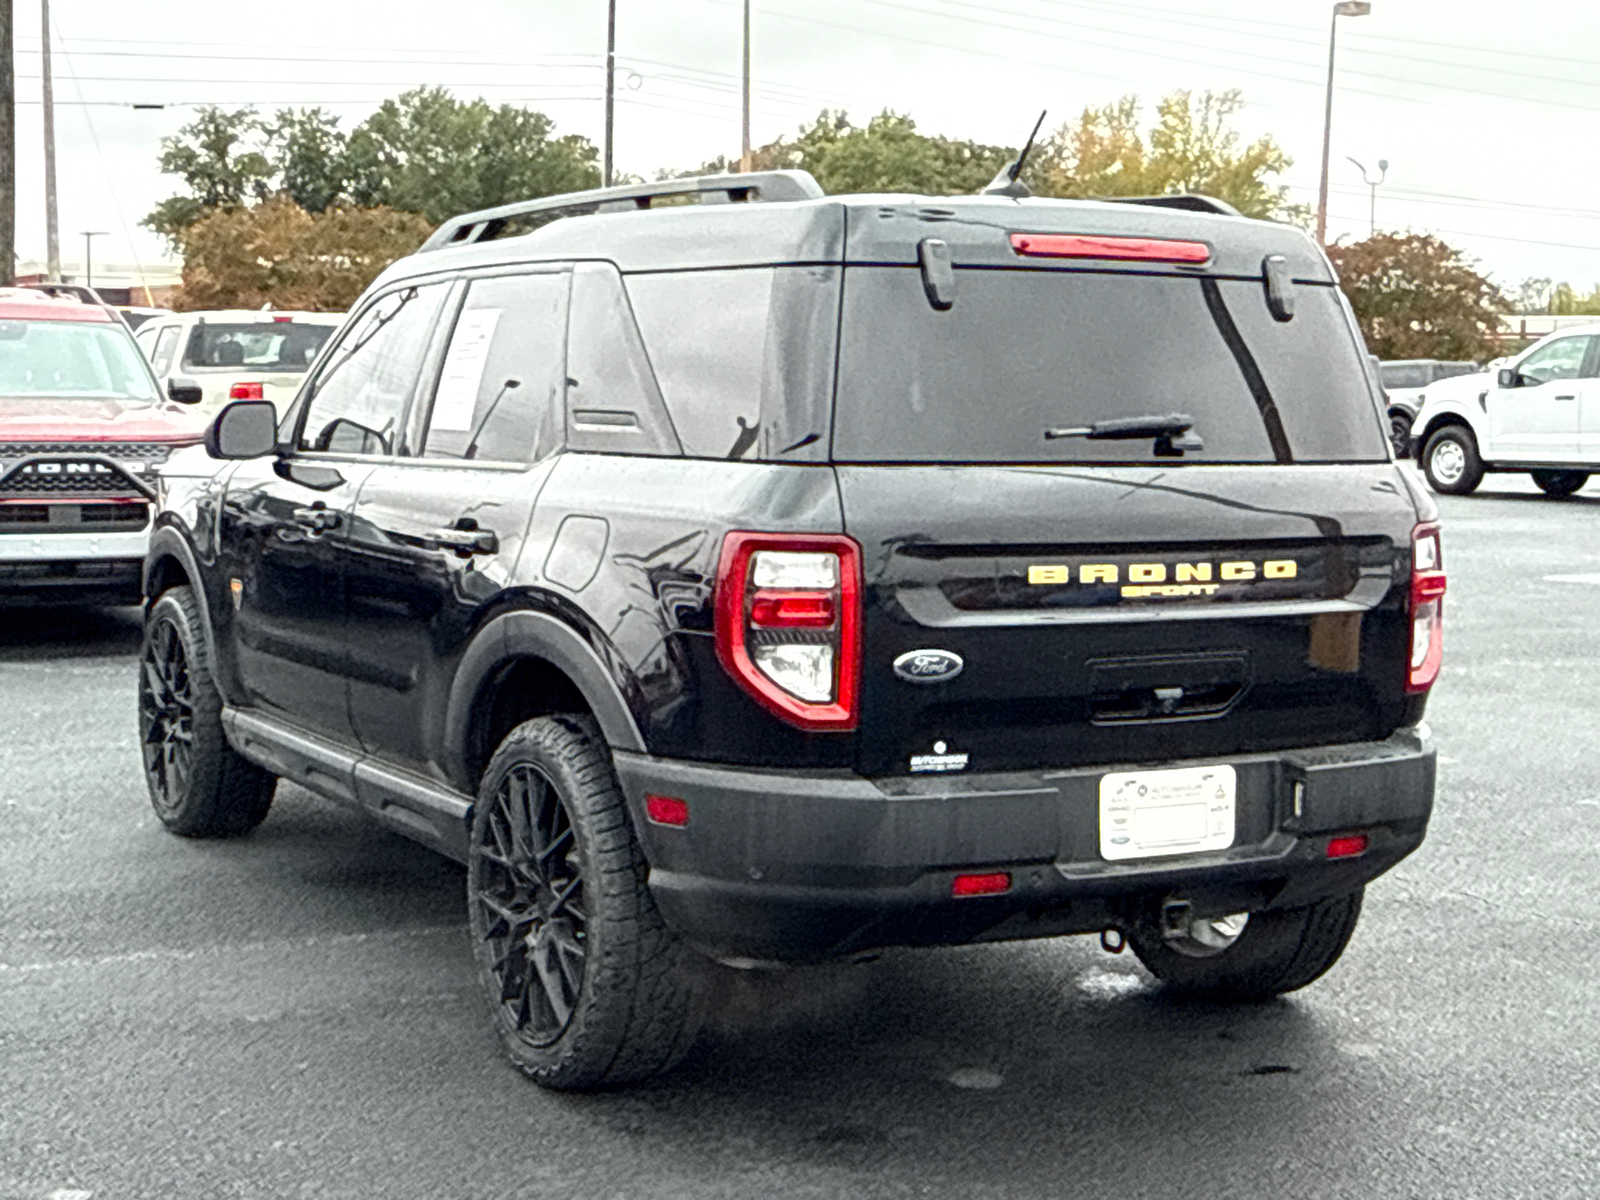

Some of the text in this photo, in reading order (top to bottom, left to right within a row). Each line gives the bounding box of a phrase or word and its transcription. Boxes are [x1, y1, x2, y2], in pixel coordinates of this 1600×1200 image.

[1027, 560, 1298, 584] BRONCO
[1120, 584, 1220, 598] SPORT
[910, 655, 949, 675] Ford
